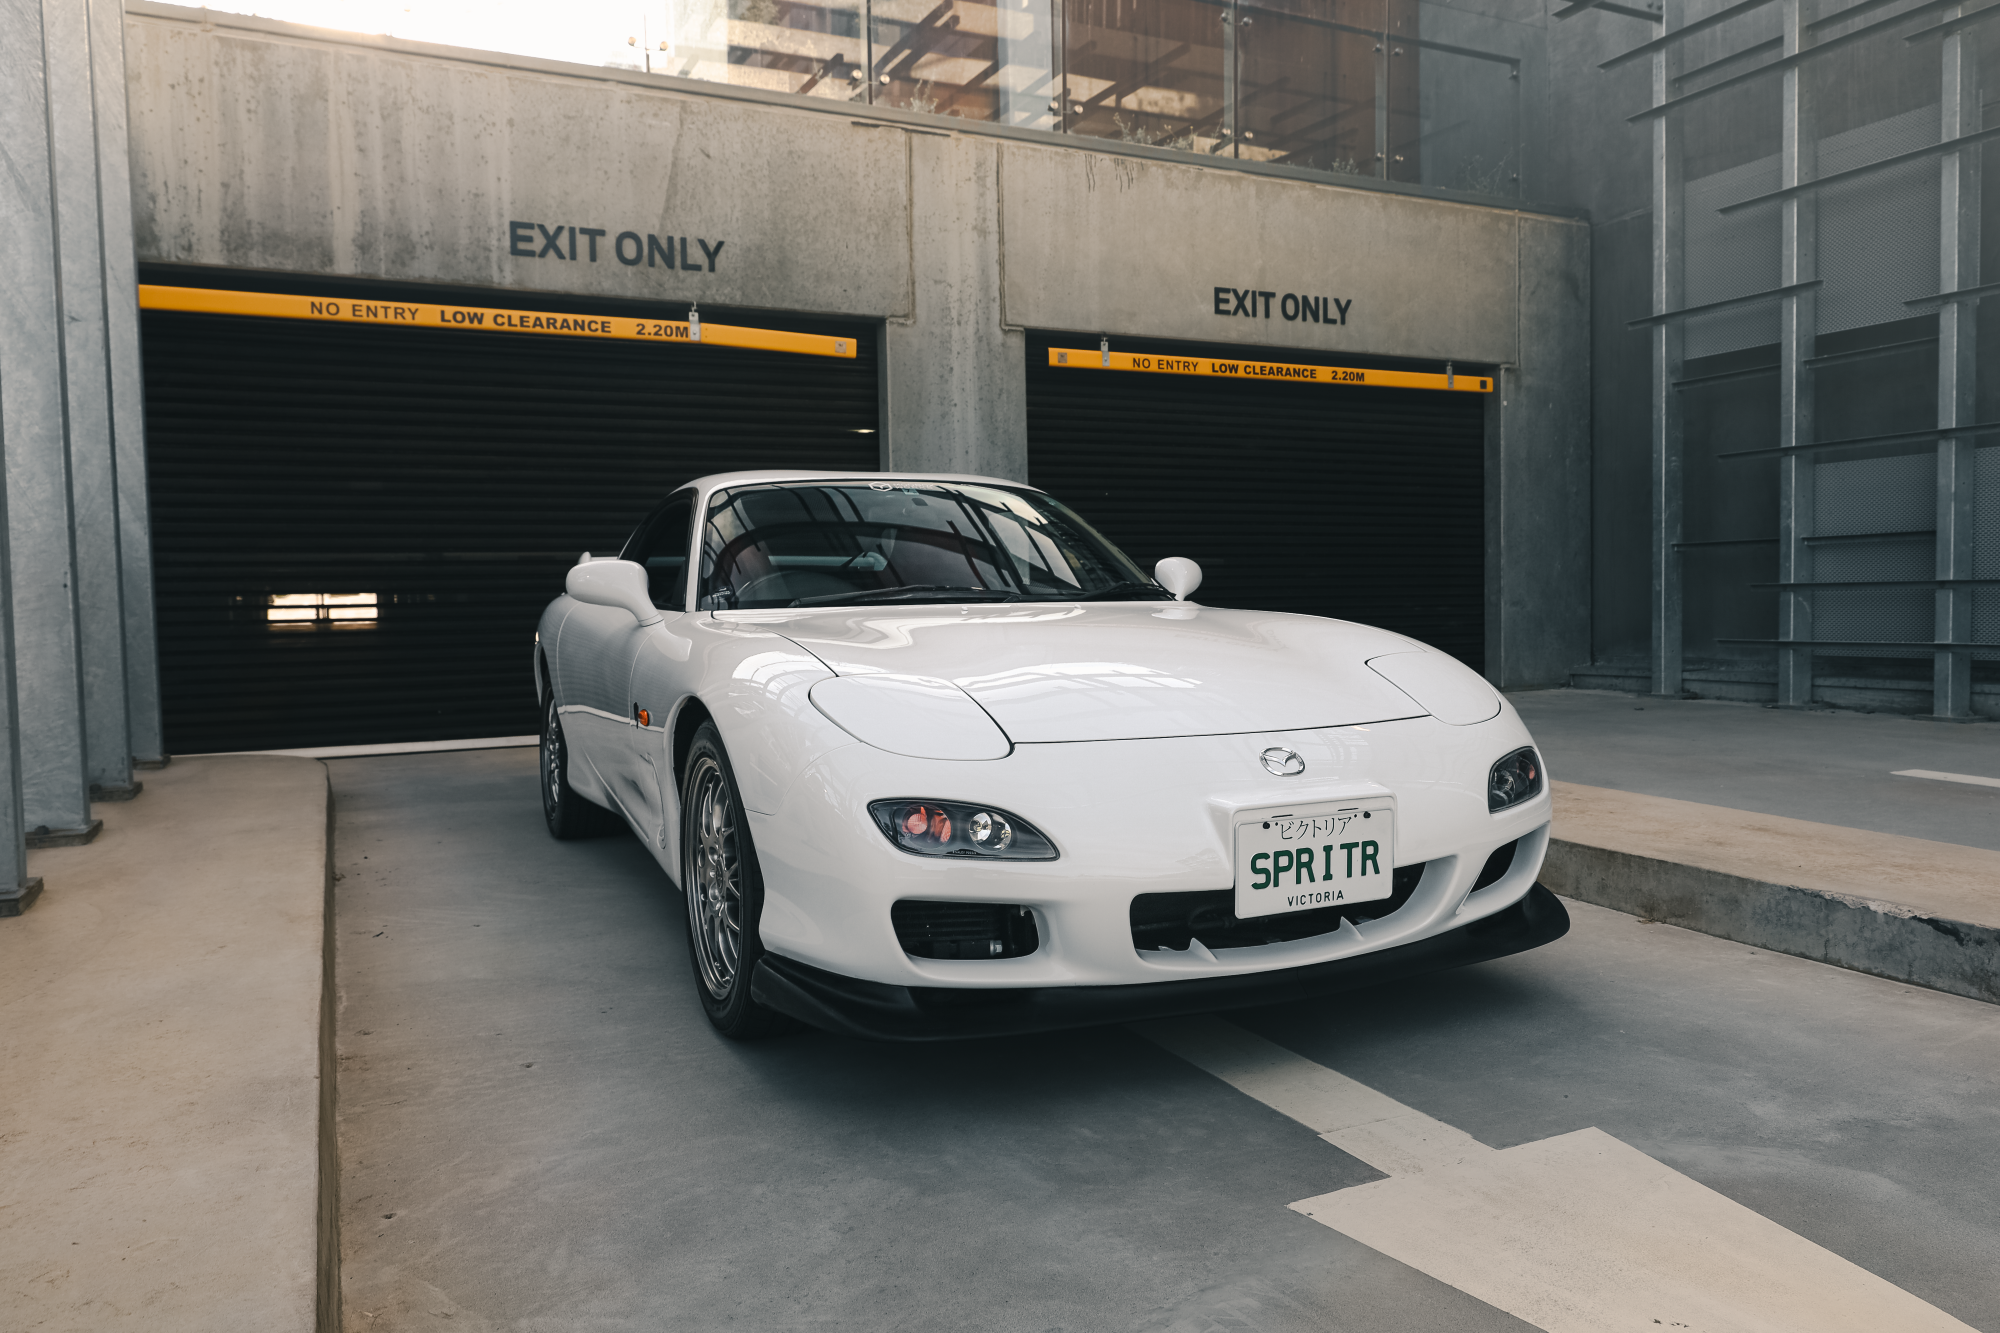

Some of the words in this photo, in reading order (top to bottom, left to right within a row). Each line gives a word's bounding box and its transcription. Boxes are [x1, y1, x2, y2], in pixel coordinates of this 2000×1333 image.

[509, 220, 606, 263] EXIT
[615, 231, 725, 273] ONLY
[310, 301, 340, 316] NO
[351, 304, 419, 321] ENTRY
[440, 310, 484, 325] LOW
[493, 313, 612, 334] CLEARANCE
[635, 323, 689, 339] 2.20M
[1214, 286, 1276, 319] EXIT
[1281, 293, 1352, 326] ONLY
[1132, 357, 1151, 369] NO
[1157, 359, 1199, 372] ENTRY
[1211, 362, 1239, 375] LOW
[1243, 365, 1317, 379] CLEARANCE
[1331, 370, 1365, 382] 2.20M
[1280, 816, 1352, 840] ビクトリア
[1250, 839, 1381, 890] SPRITR
[1287, 889, 1344, 908] VICTORIA
